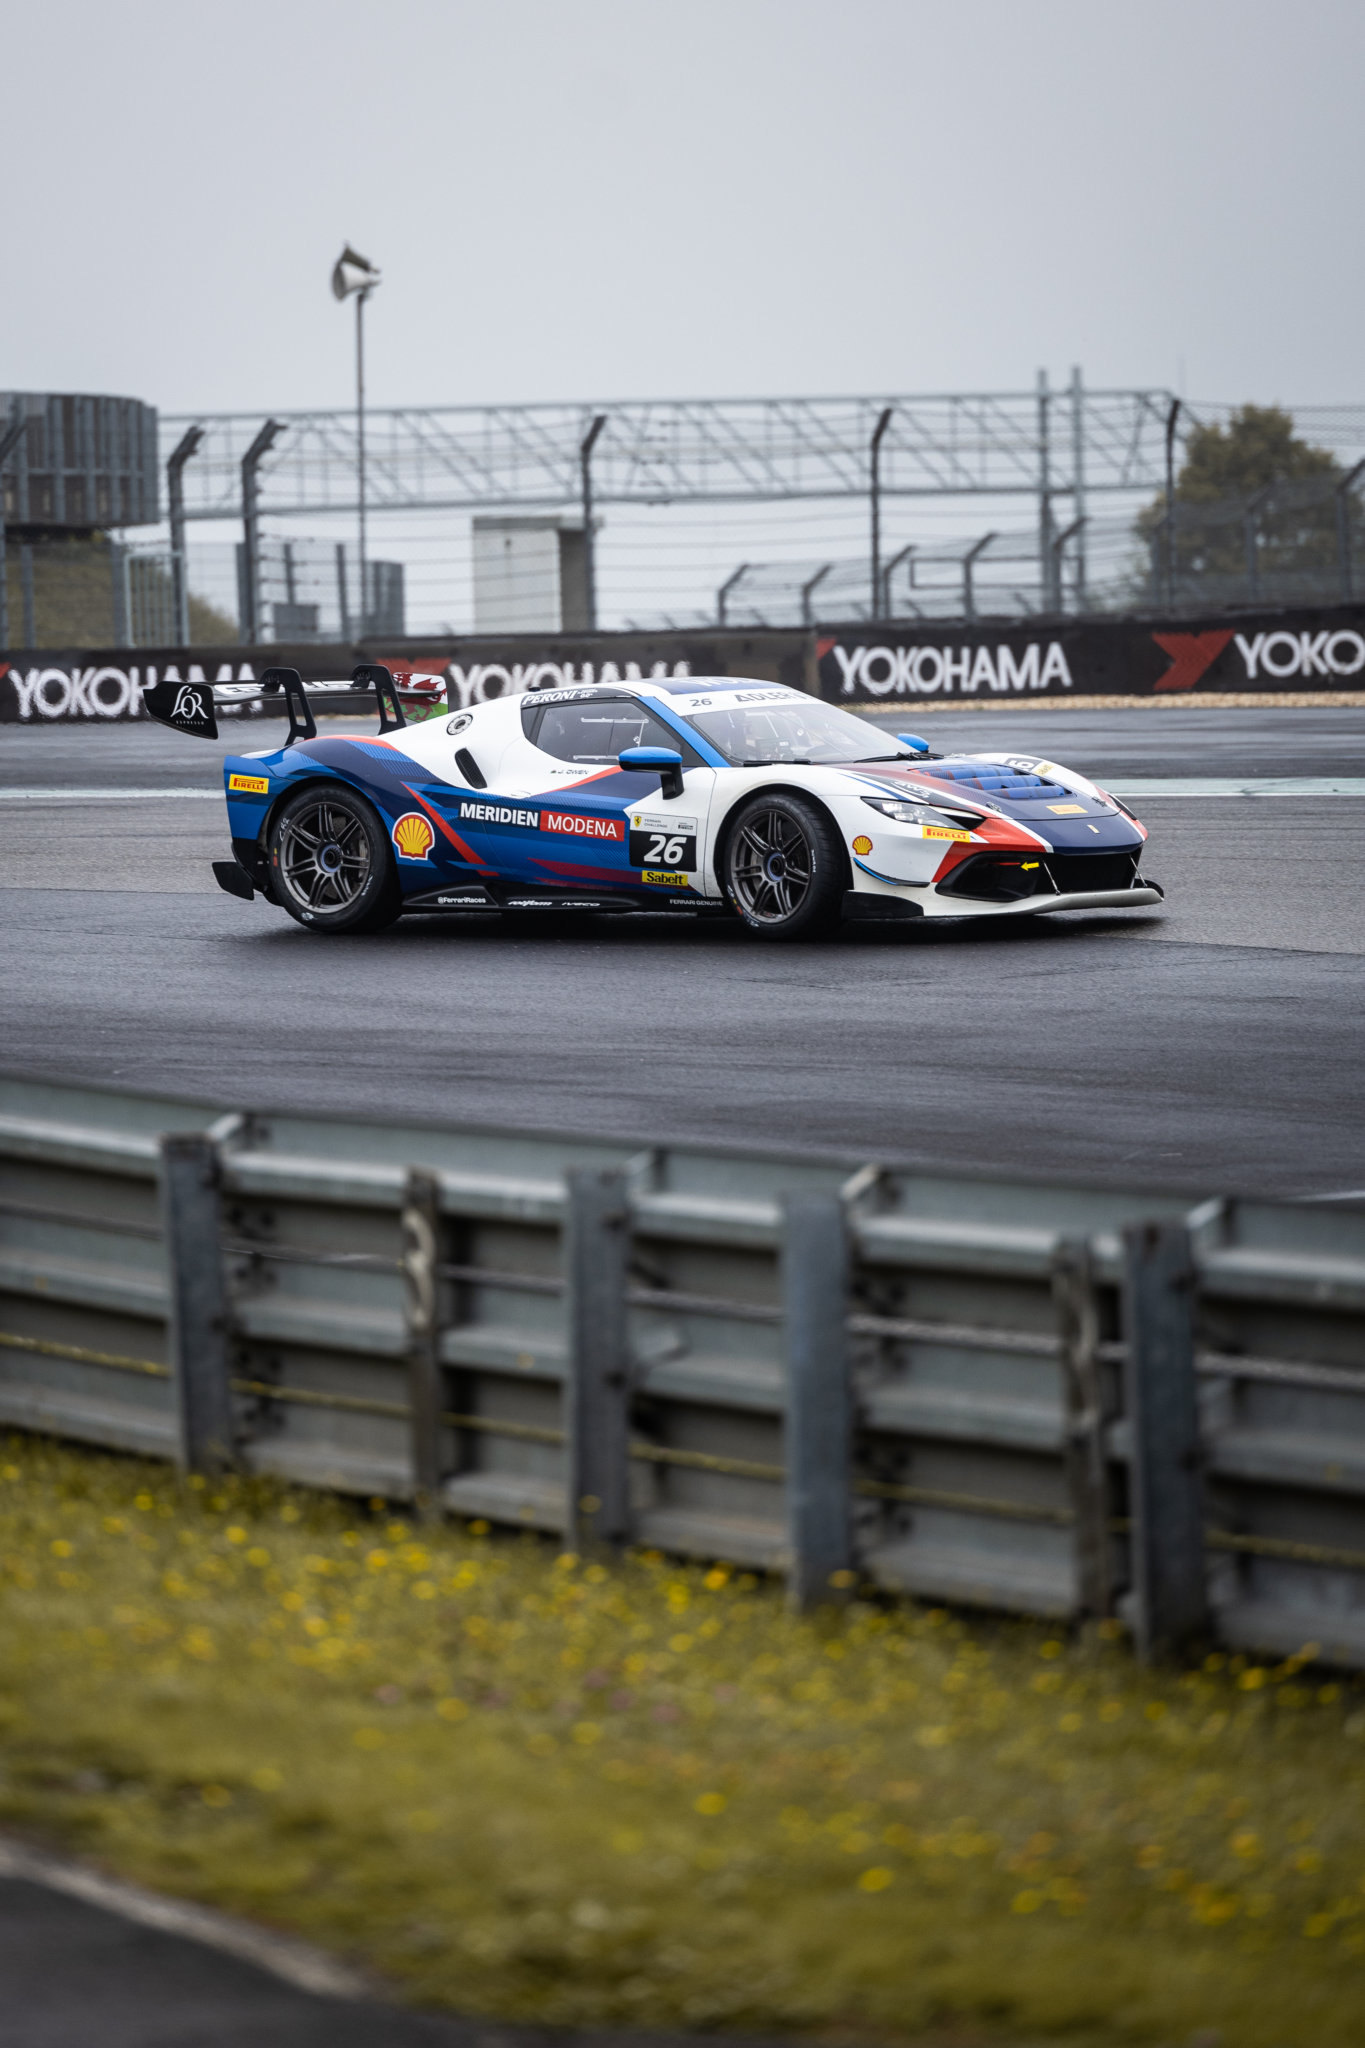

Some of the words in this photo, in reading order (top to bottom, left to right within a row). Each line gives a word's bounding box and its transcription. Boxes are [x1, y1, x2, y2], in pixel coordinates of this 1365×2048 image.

[1234, 629, 1365, 679] YOKO
[833, 642, 1073, 696] YOKOHAMA
[521, 690, 578, 705] PERONI
[689, 698, 712, 707] 26
[233, 777, 265, 790] PIRELLI
[460, 802, 539, 827] MERIDIEN
[547, 814, 617, 838] MODENA
[926, 827, 967, 840] PIRELLI
[643, 834, 687, 864] 26
[646, 872, 684, 884] Sabelt
